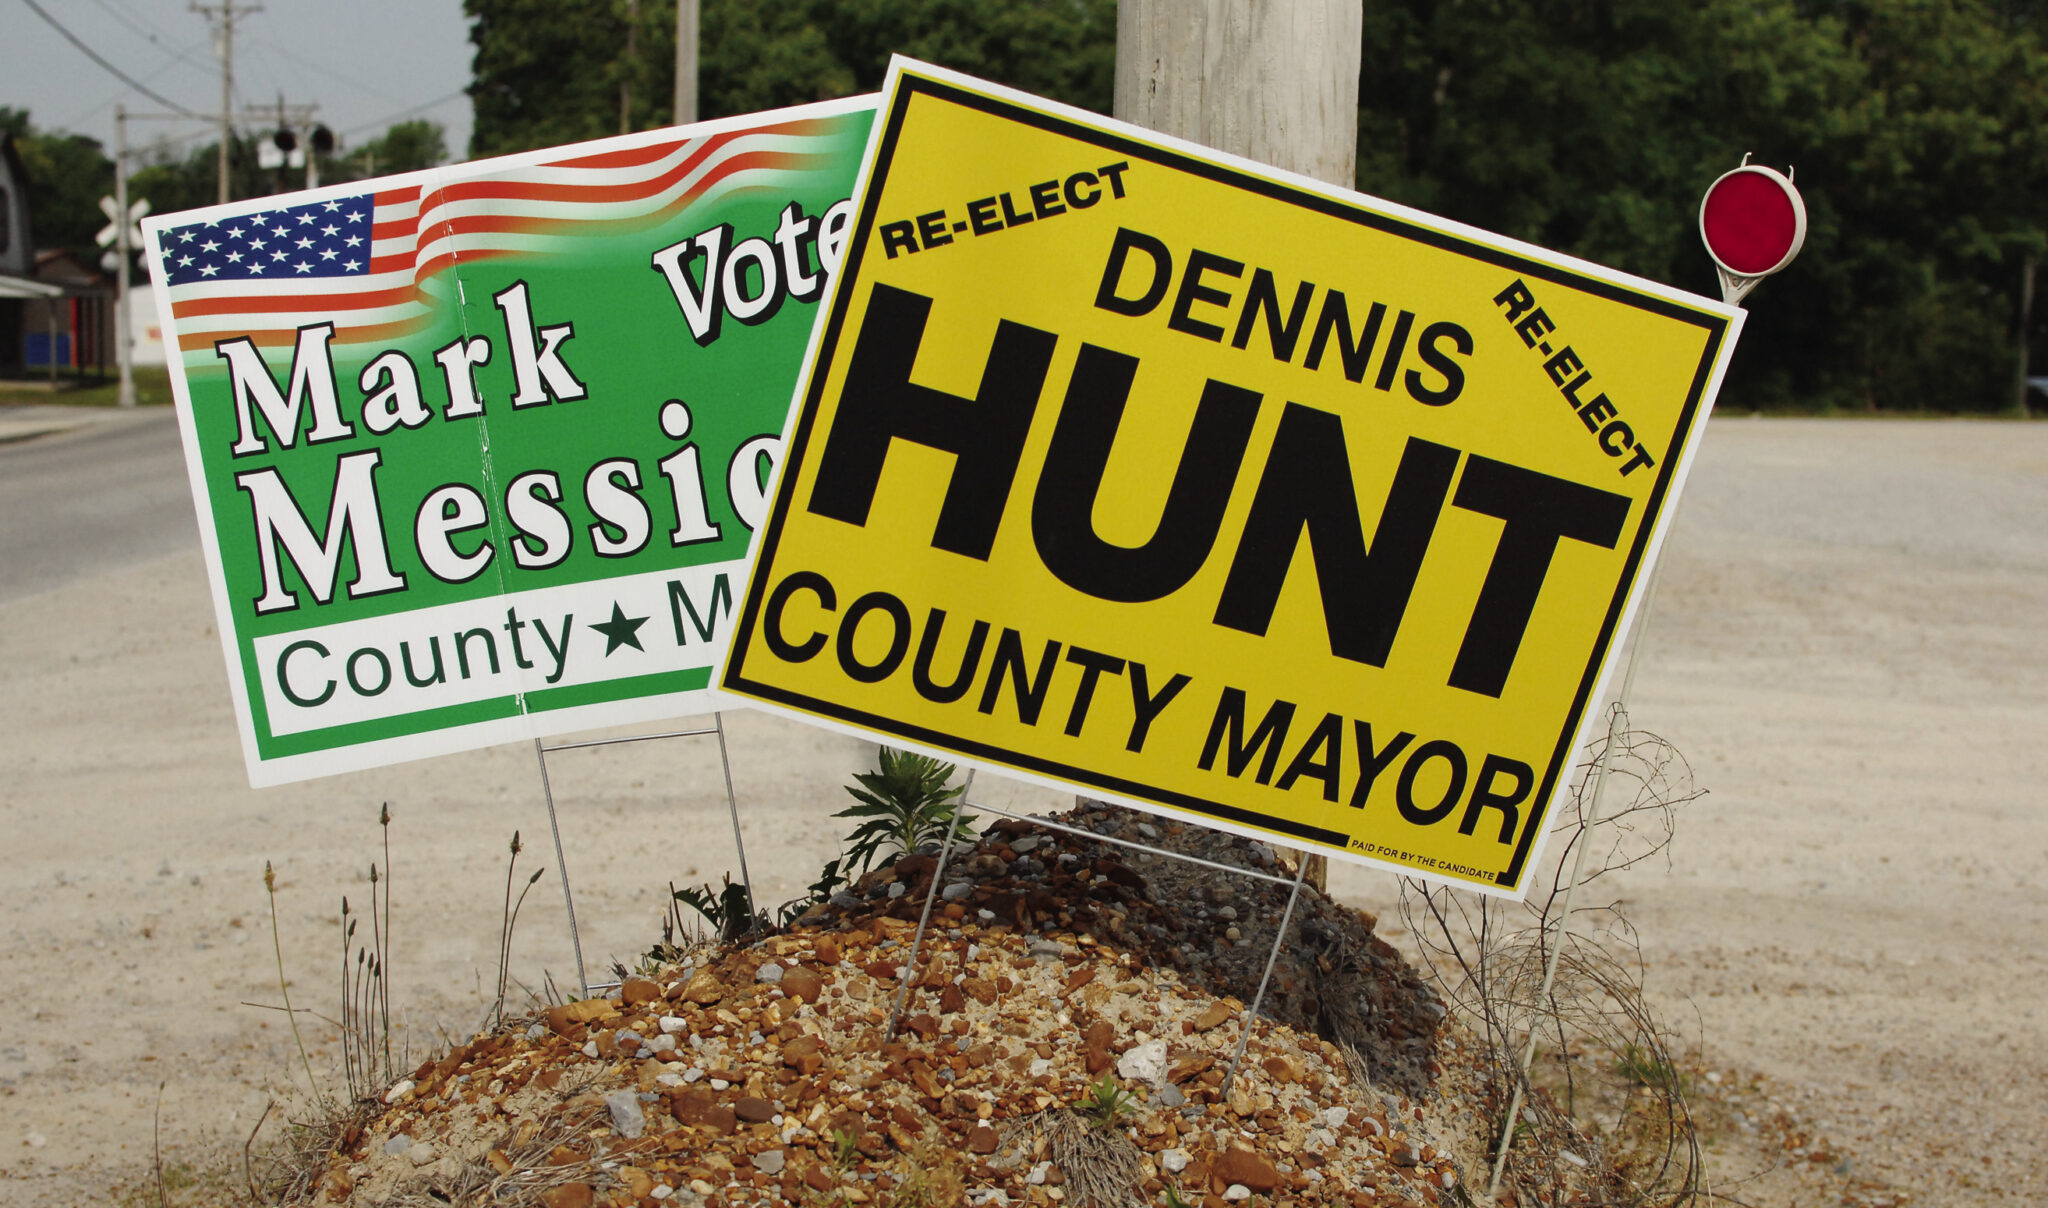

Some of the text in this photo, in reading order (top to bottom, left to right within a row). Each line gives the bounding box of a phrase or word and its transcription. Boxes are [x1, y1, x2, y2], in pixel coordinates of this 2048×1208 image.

[651, 198, 851, 348] Vote
[879, 161, 1130, 260] RE-ELECT
[215, 279, 588, 458] Mark
[1093, 226, 1475, 407] DENNIS
[1492, 278, 1656, 478] RE-ELECT
[806, 282, 1633, 699] HUNT
[276, 606, 574, 708] County
[763, 570, 1536, 845] COUNTY MAYOR
[1351, 839, 1496, 881] PAID FOR BY THE CANDIDATE
